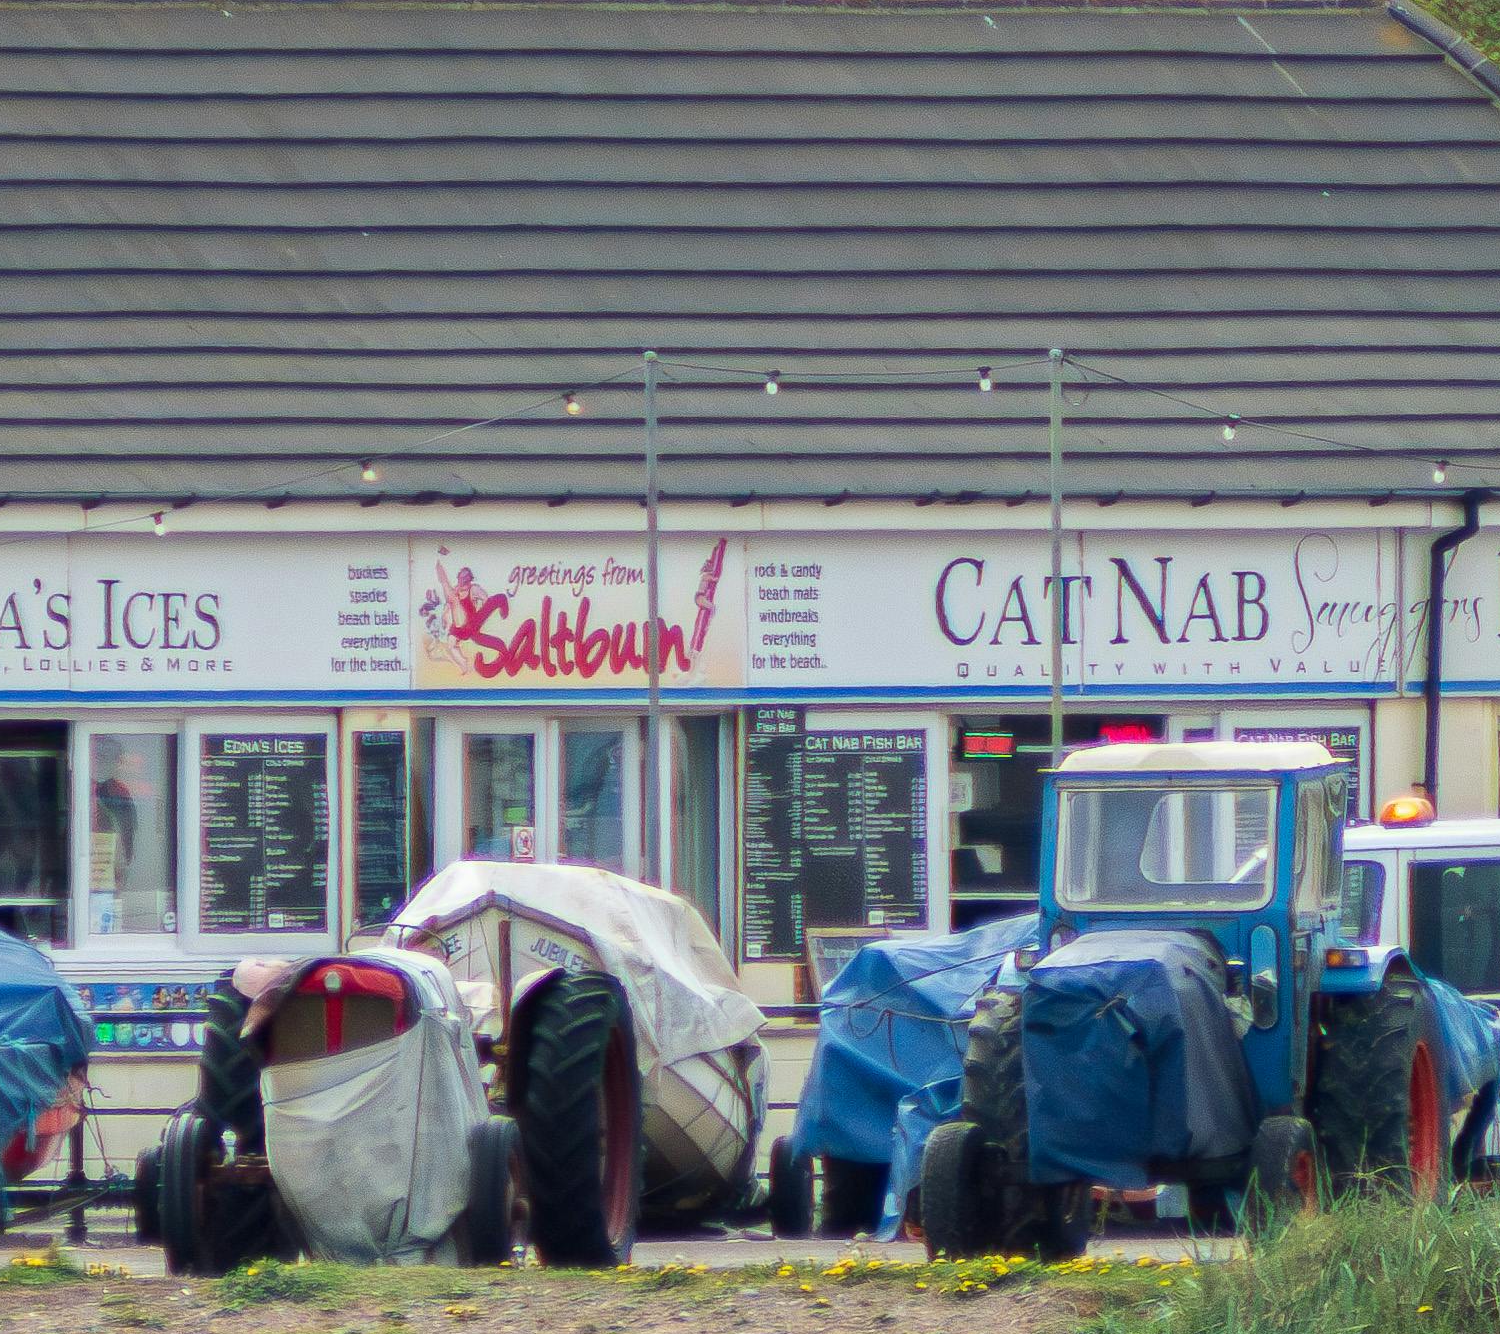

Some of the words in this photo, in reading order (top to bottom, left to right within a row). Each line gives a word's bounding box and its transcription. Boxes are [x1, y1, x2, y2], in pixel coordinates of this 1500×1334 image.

[506, 560, 596, 597] greetings
[601, 556, 646, 586] from
[755, 563, 776, 578] rock
[780, 563, 789, 578] &
[791, 563, 822, 580] candy
[349, 588, 388, 604] spades
[758, 586, 790, 601] beach
[793, 586, 820, 601] mats
[935, 556, 1093, 646] CAT
[1108, 556, 1271, 645] NAB
[96, 579, 221, 651] ICES
[338, 611, 371, 626] beach
[759, 608, 820, 623] windbreaks
[341, 634, 398, 651] everything
[762, 631, 817, 648] everything
[23, 656, 127, 672] LOLLIES
[140, 657, 153, 672] &
[166, 657, 233, 672] MORE
[330, 657, 346, 672] for
[349, 657, 367, 673] the
[752, 654, 766, 669] for
[769, 654, 786, 669] the
[956, 662, 1125, 678] QUALITY
[1152, 662, 1241, 676] WITH
[1269, 658, 1387, 674] VALUE
[757, 709, 776, 720] CAT
[756, 723, 777, 733] FISH
[223, 739, 271, 754] EDNA'S
[274, 738, 306, 754] ICES
[804, 735, 829, 751] CAT
[832, 735, 861, 750] NAB
[863, 735, 894, 750] FISH
[896, 734, 923, 750] BAR
[1330, 732, 1356, 746] BAR
